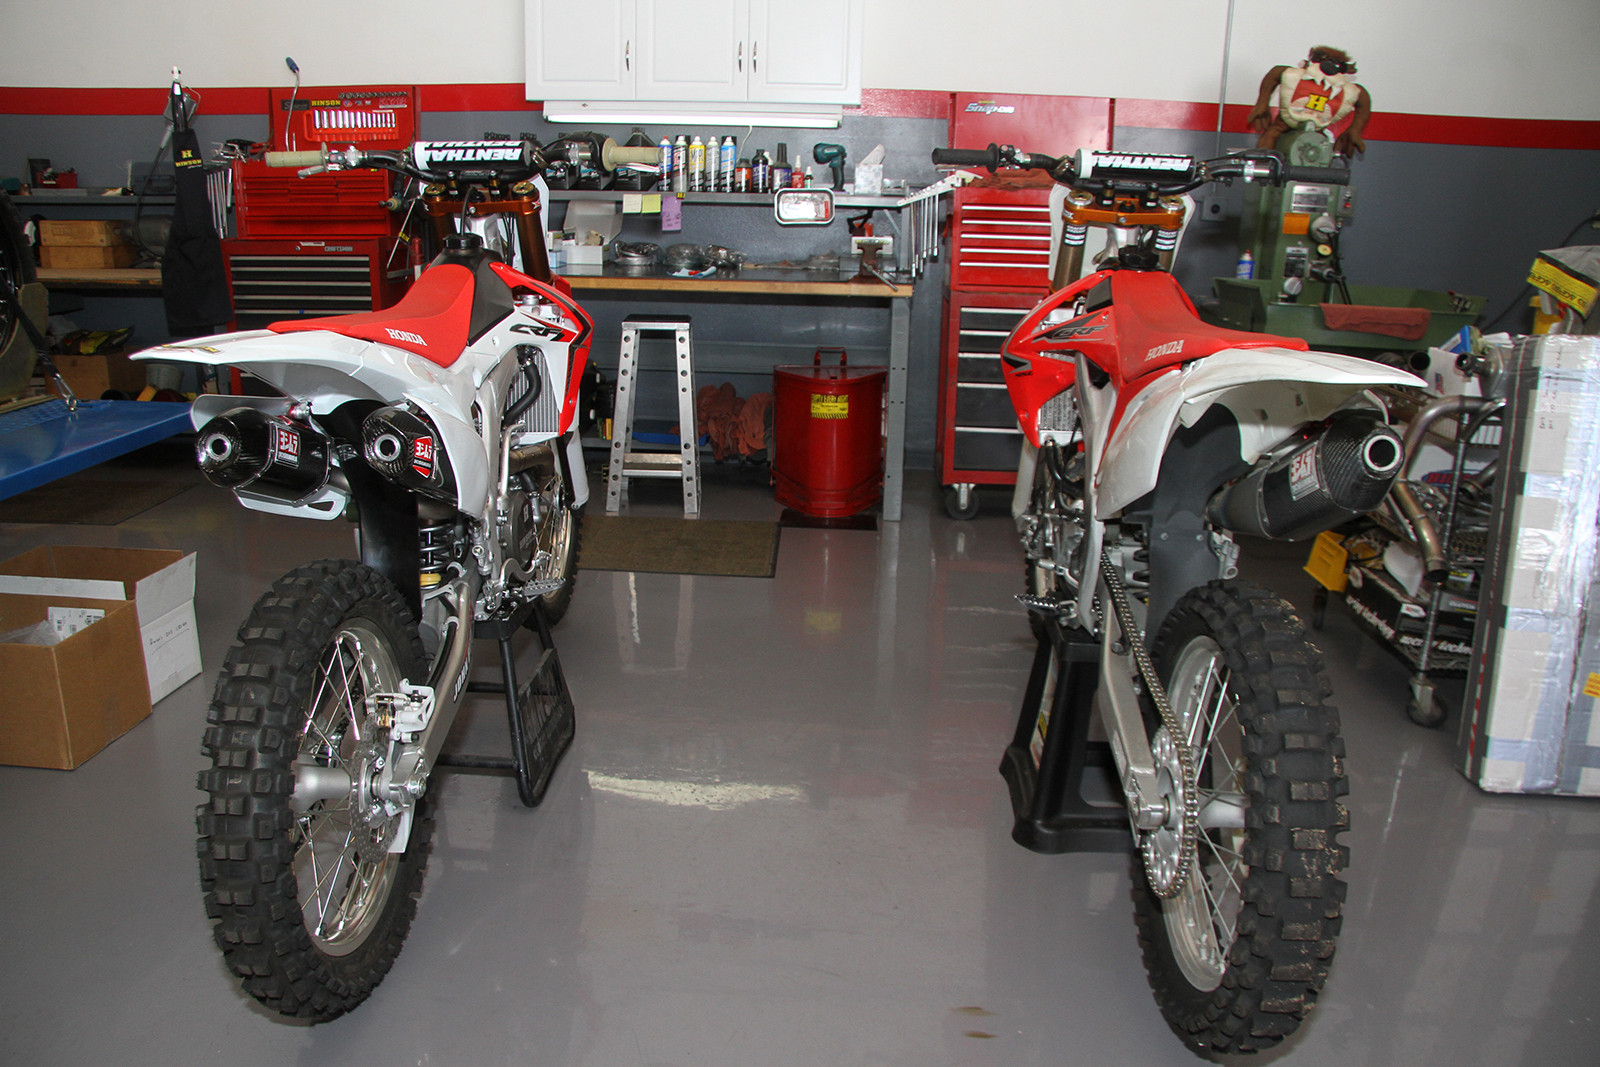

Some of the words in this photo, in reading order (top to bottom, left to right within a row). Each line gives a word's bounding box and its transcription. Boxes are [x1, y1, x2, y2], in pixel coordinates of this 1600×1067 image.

[965, 103, 1015, 115] Snap-on
[1306, 93, 1329, 112] H
[385, 328, 428, 347] HONDA
[1144, 339, 1185, 362] HONDA
